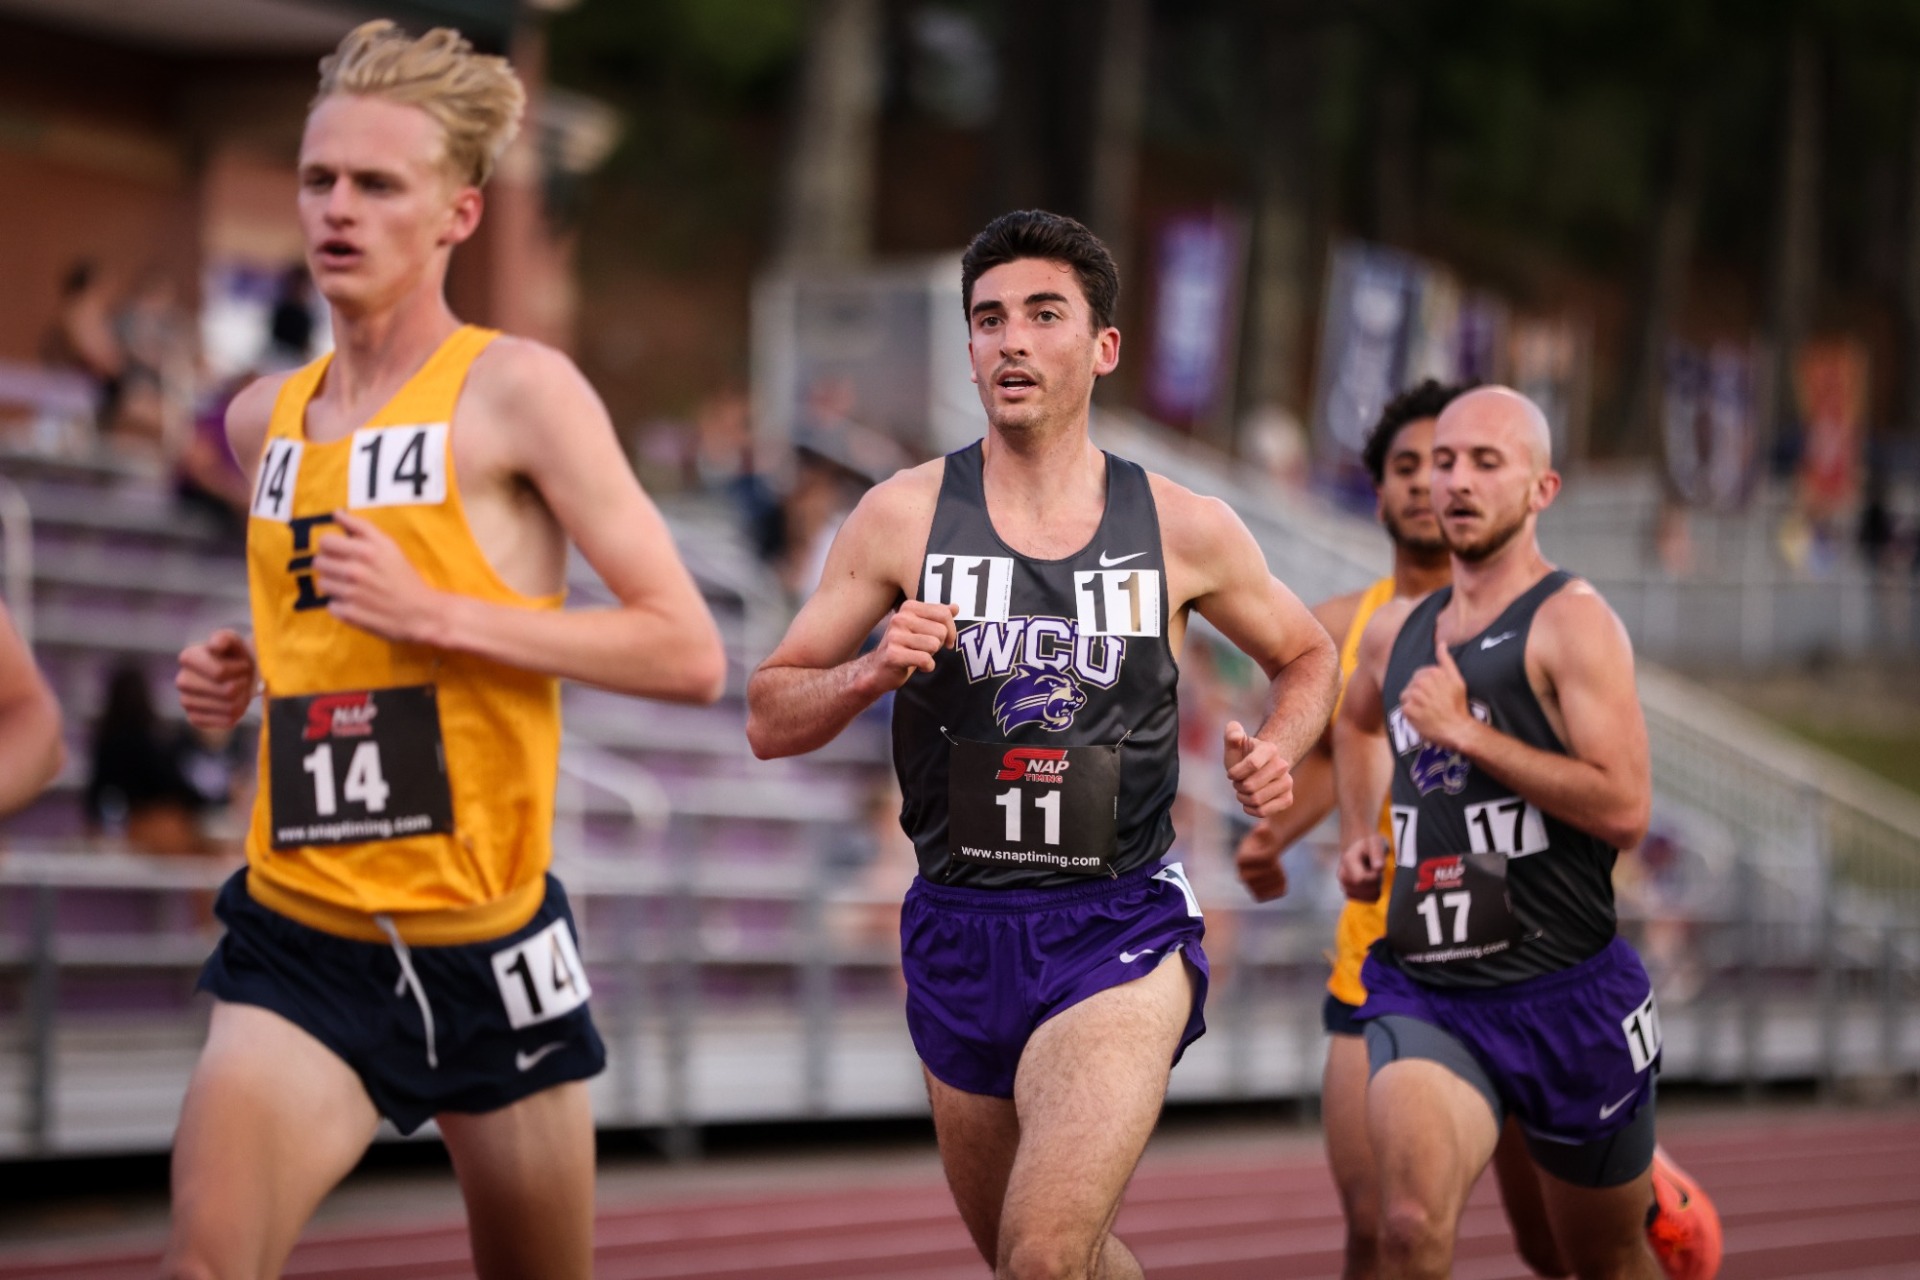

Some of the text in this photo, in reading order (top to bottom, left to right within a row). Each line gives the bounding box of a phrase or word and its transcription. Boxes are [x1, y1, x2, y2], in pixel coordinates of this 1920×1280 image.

[254, 446, 294, 515] 14
[361, 431, 429, 499] 14
[932, 557, 991, 618] 11
[1082, 572, 1142, 633] 11
[956, 615, 1126, 690] WCU
[303, 741, 390, 816] 14
[995, 748, 1070, 781] SNAP
[1024, 773, 1064, 784] TIMING
[996, 787, 1061, 845] 11
[1395, 812, 1409, 855] 7
[1472, 801, 1526, 853] 17
[961, 846, 1101, 868] www.snaptiming.com
[1416, 890, 1472, 946] 17
[505, 933, 580, 1016] 14
